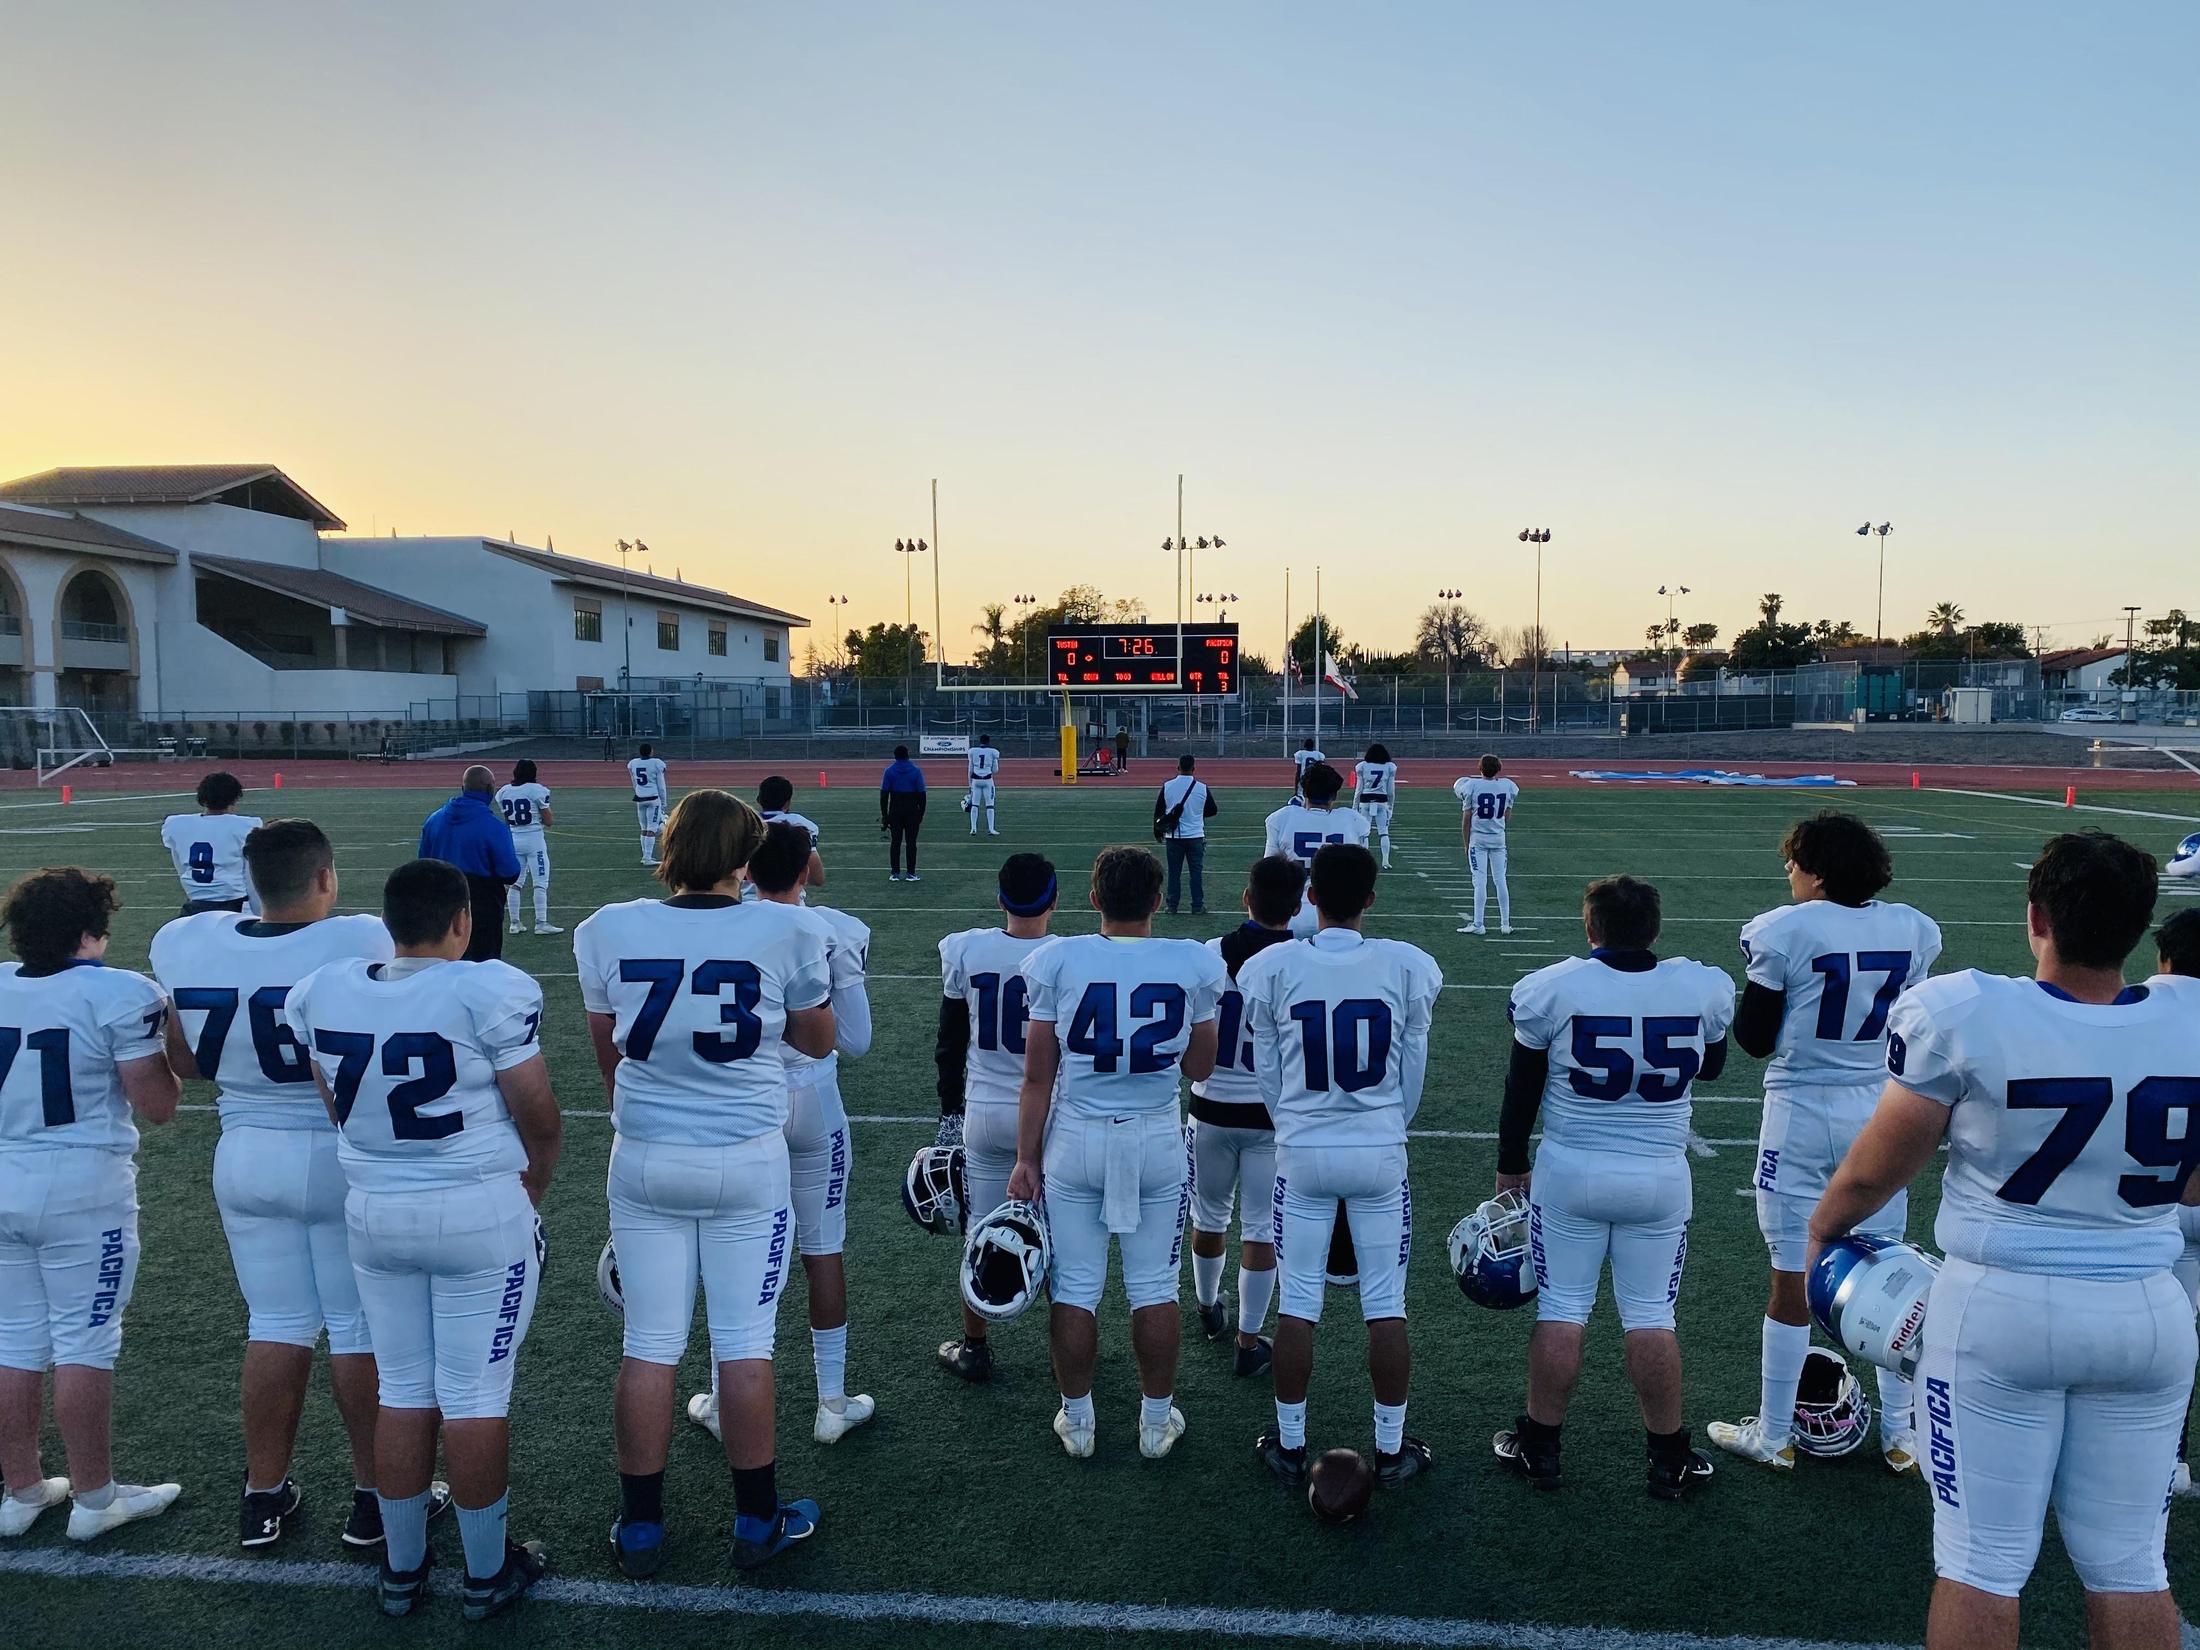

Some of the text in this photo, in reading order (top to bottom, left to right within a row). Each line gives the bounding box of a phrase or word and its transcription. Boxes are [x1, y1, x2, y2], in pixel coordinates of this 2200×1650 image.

[1067, 652, 1076, 666] 0
[1118, 638, 1154, 655] 7:26
[1221, 650, 1229, 664] 0
[1221, 681, 1228, 692] 3
[635, 767, 648, 786] 5
[978, 754, 986, 769] 1
[1370, 770, 1384, 788] 7
[502, 798, 533, 826] 28
[1477, 792, 1507, 820] 81
[189, 841, 215, 883] 9
[173, 986, 315, 1083] 76
[619, 959, 763, 1063] 73
[1067, 982, 1186, 1074] 42
[1811, 951, 1912, 1041] 17
[314, 1027, 464, 1140] 72
[1289, 998, 1392, 1093] 10
[1568, 1014, 1701, 1102] 55
[825, 1127, 845, 1210] PACIFICA
[1994, 1075, 2200, 1208] 79
[758, 1206, 788, 1306] PACIFICA
[1169, 1181, 1188, 1266] PACIFICA
[1273, 1175, 1287, 1260] PACIFICA
[1398, 1178, 1411, 1267] PACIFICA
[1530, 1203, 1550, 1290] PACIFICA
[87, 1226, 124, 1329] PACIFICA
[487, 1258, 526, 1364] PACIFICA
[1891, 1300, 1925, 1352] Riddell
[1926, 1376, 1960, 1509] PACIFICA
